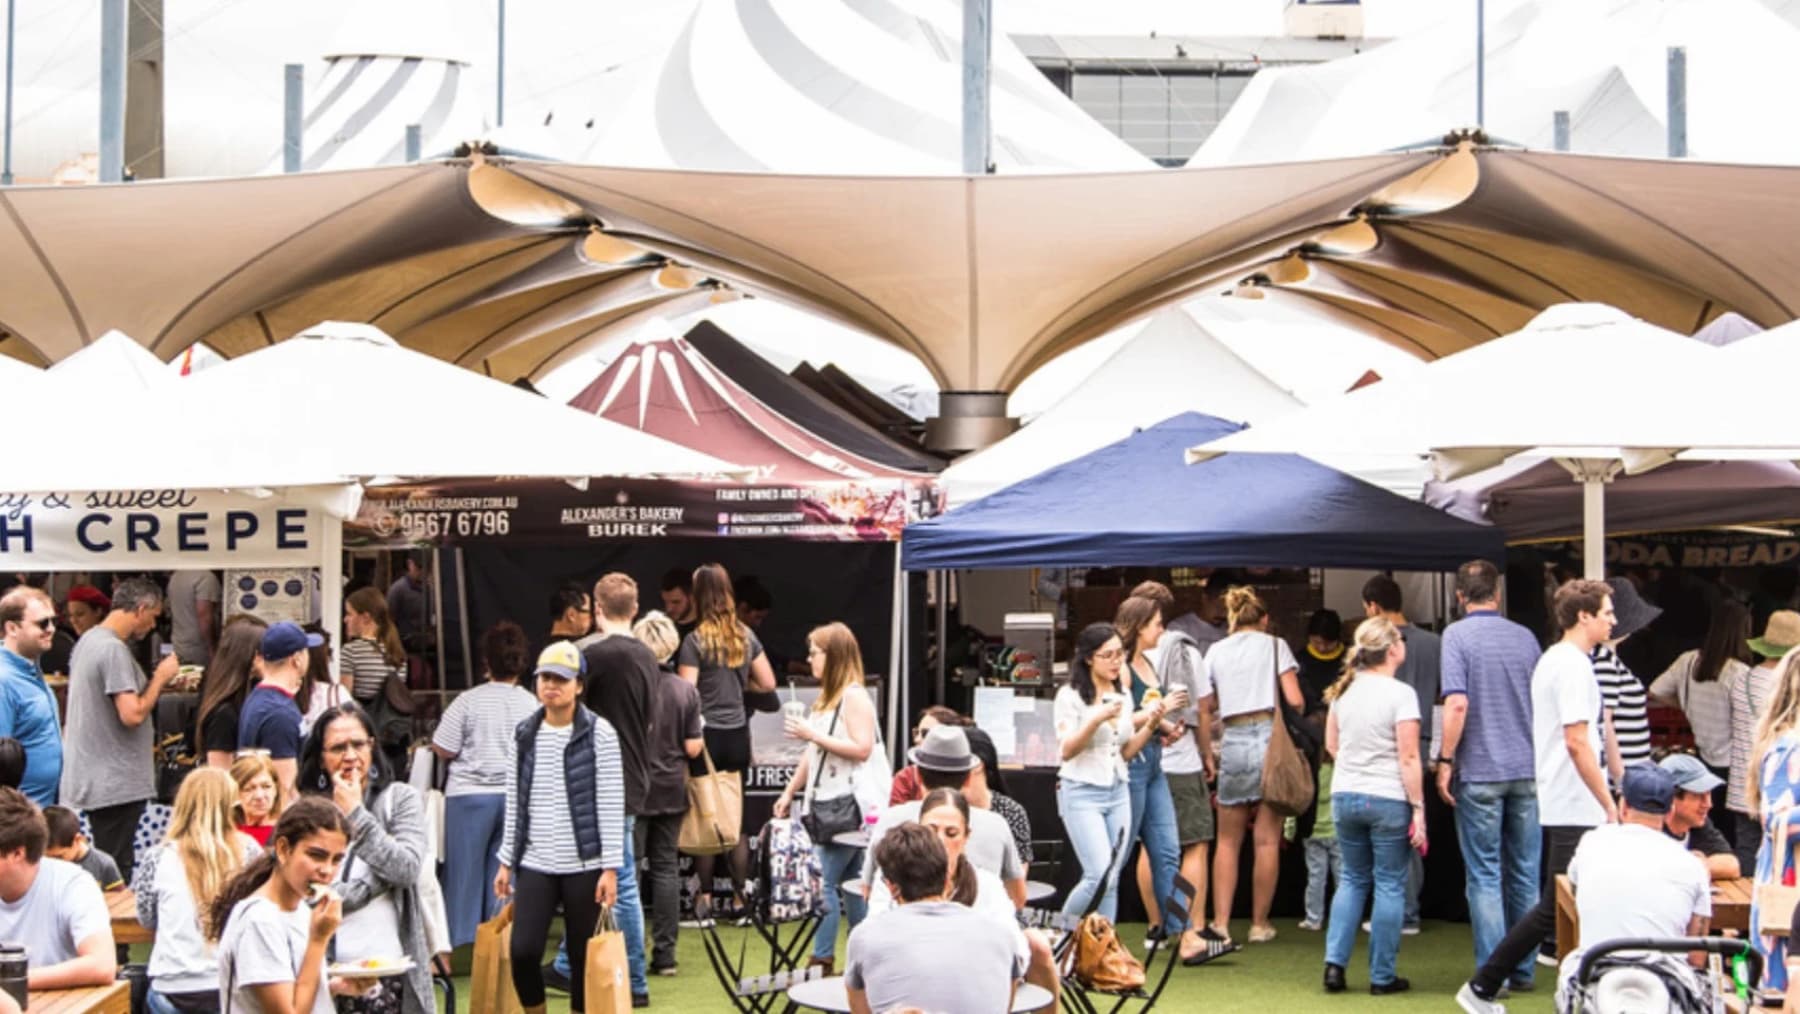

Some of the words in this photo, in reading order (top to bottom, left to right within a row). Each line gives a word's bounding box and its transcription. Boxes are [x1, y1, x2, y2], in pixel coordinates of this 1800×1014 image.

[42, 491, 72, 509] &
[83, 488, 197, 508] sweet
[715, 487, 747, 501] FAMILY
[748, 487, 779, 500] OWNED
[780, 487, 798, 500] AND
[400, 512, 451, 537] 9567
[457, 511, 510, 536] 6796
[561, 506, 637, 524] ALEXANDER'S
[639, 506, 683, 522] BAKERY
[76, 509, 308, 553] CREPE
[588, 523, 667, 537] BUREK
[1681, 541, 1800, 568] BREAD
[756, 766, 796, 786] FRES
